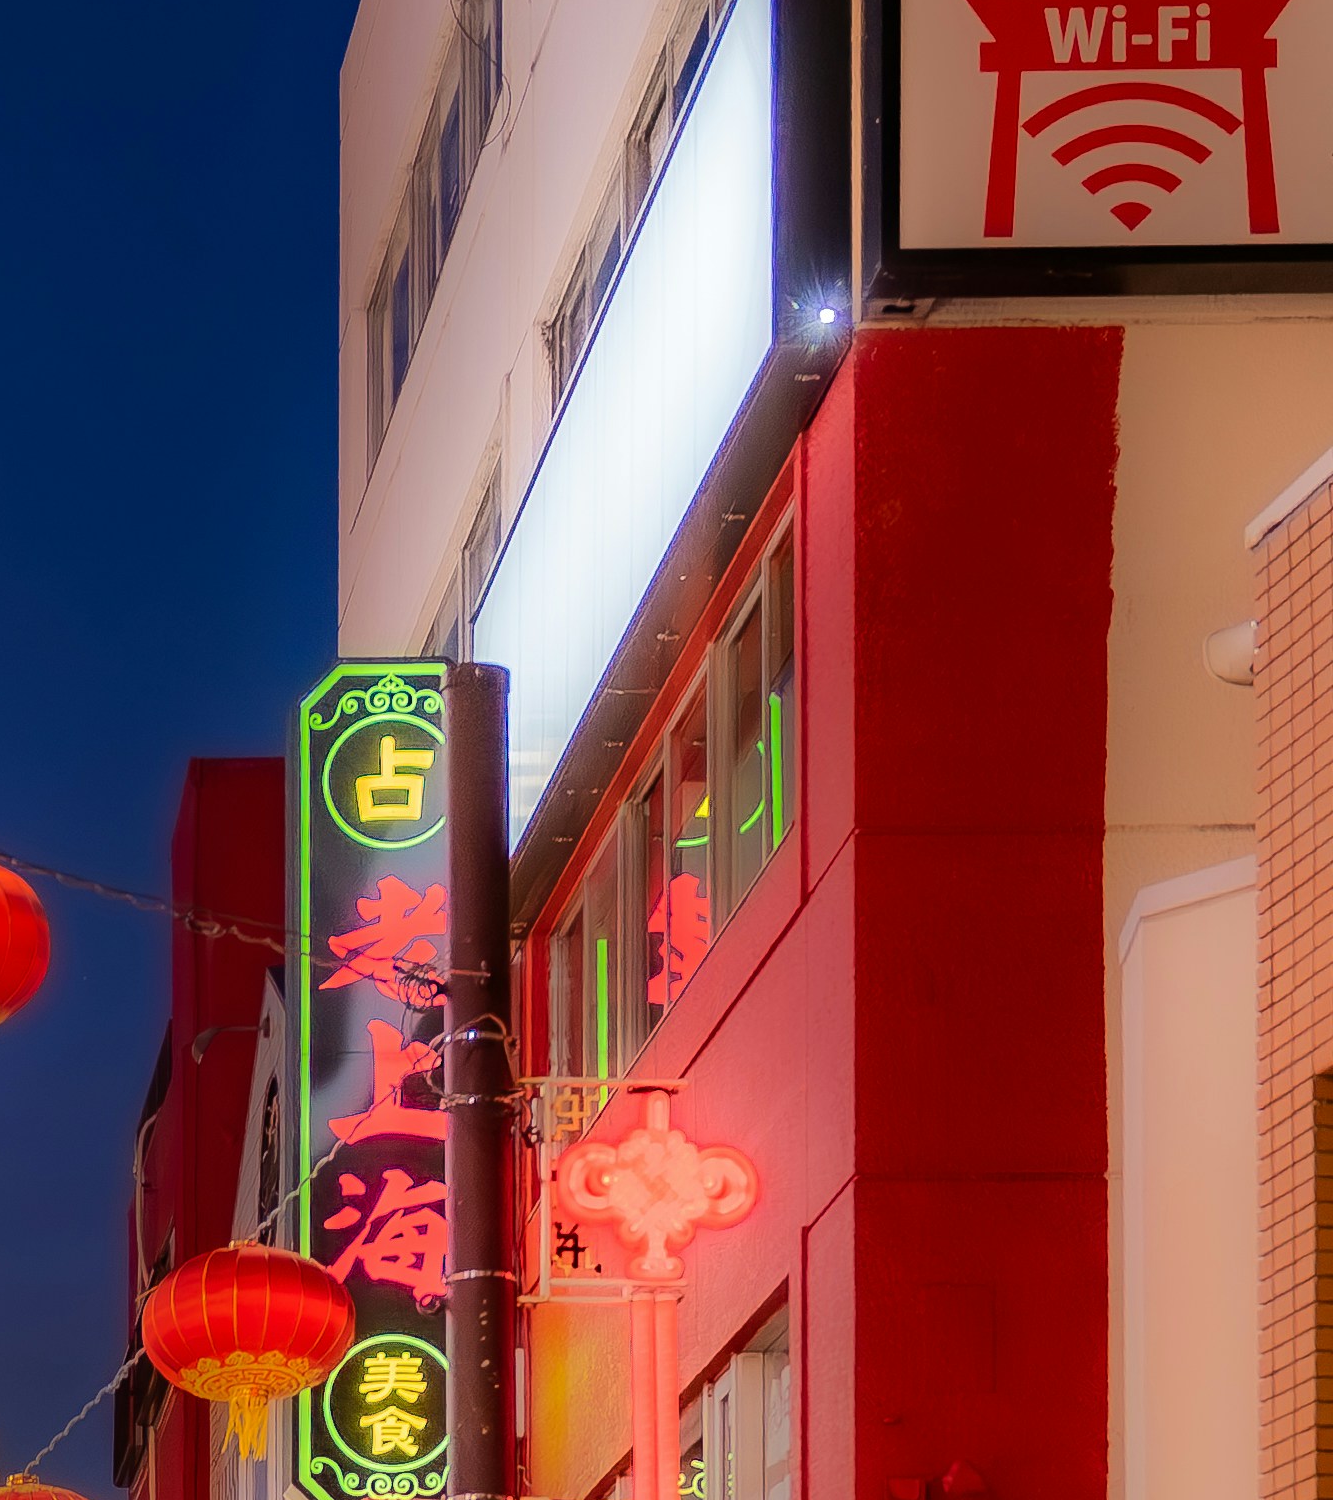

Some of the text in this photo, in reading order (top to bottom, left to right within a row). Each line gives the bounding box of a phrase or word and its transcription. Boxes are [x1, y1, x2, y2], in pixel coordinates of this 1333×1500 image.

[1044, 6, 1210, 65] Wi-Fi
[319, 872, 448, 1302] 老上海
[357, 1352, 428, 1458] 美食
